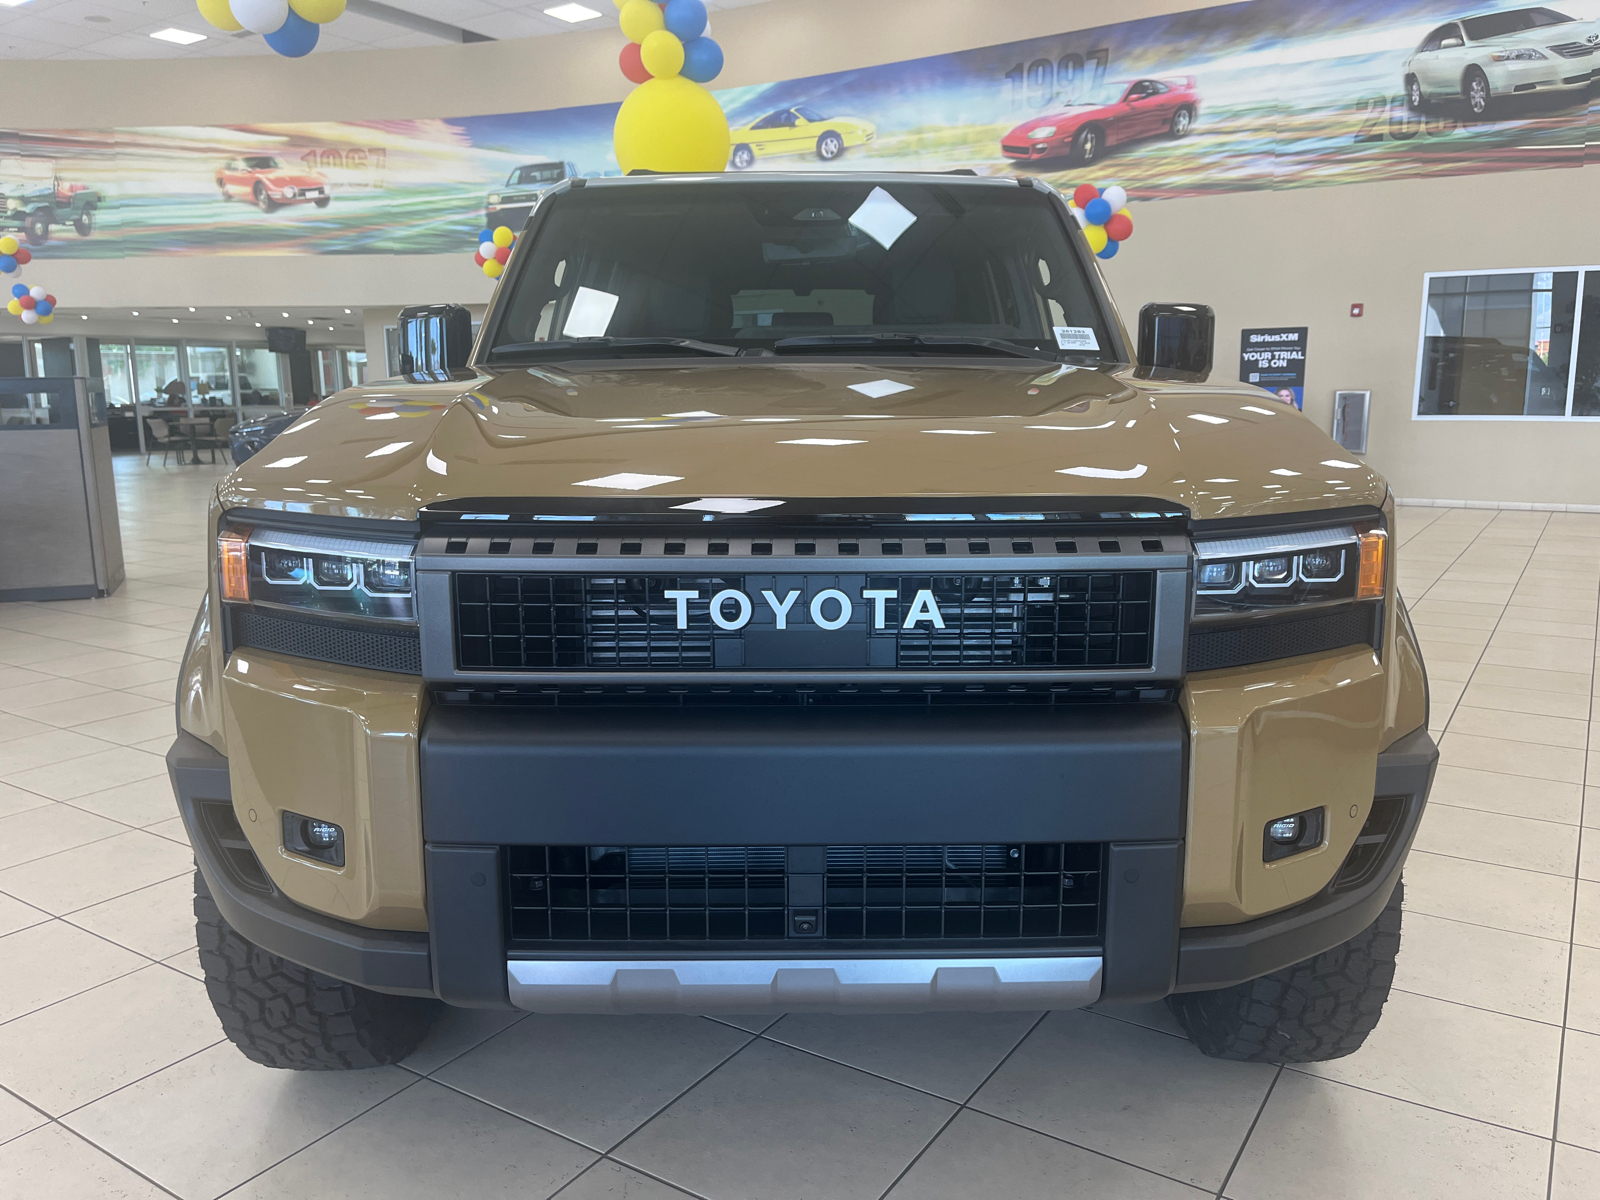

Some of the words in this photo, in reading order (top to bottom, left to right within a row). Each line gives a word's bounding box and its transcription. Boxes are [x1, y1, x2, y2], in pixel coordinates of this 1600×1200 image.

[1004, 48, 1109, 113] 1997
[1249, 333, 1299, 343] SiriusXM
[1242, 352, 1272, 361] YOUR
[1273, 351, 1305, 360] TRIAL
[1258, 359, 1269, 368] IS
[1270, 359, 1287, 368] ON
[664, 589, 946, 630] TOYOTA
